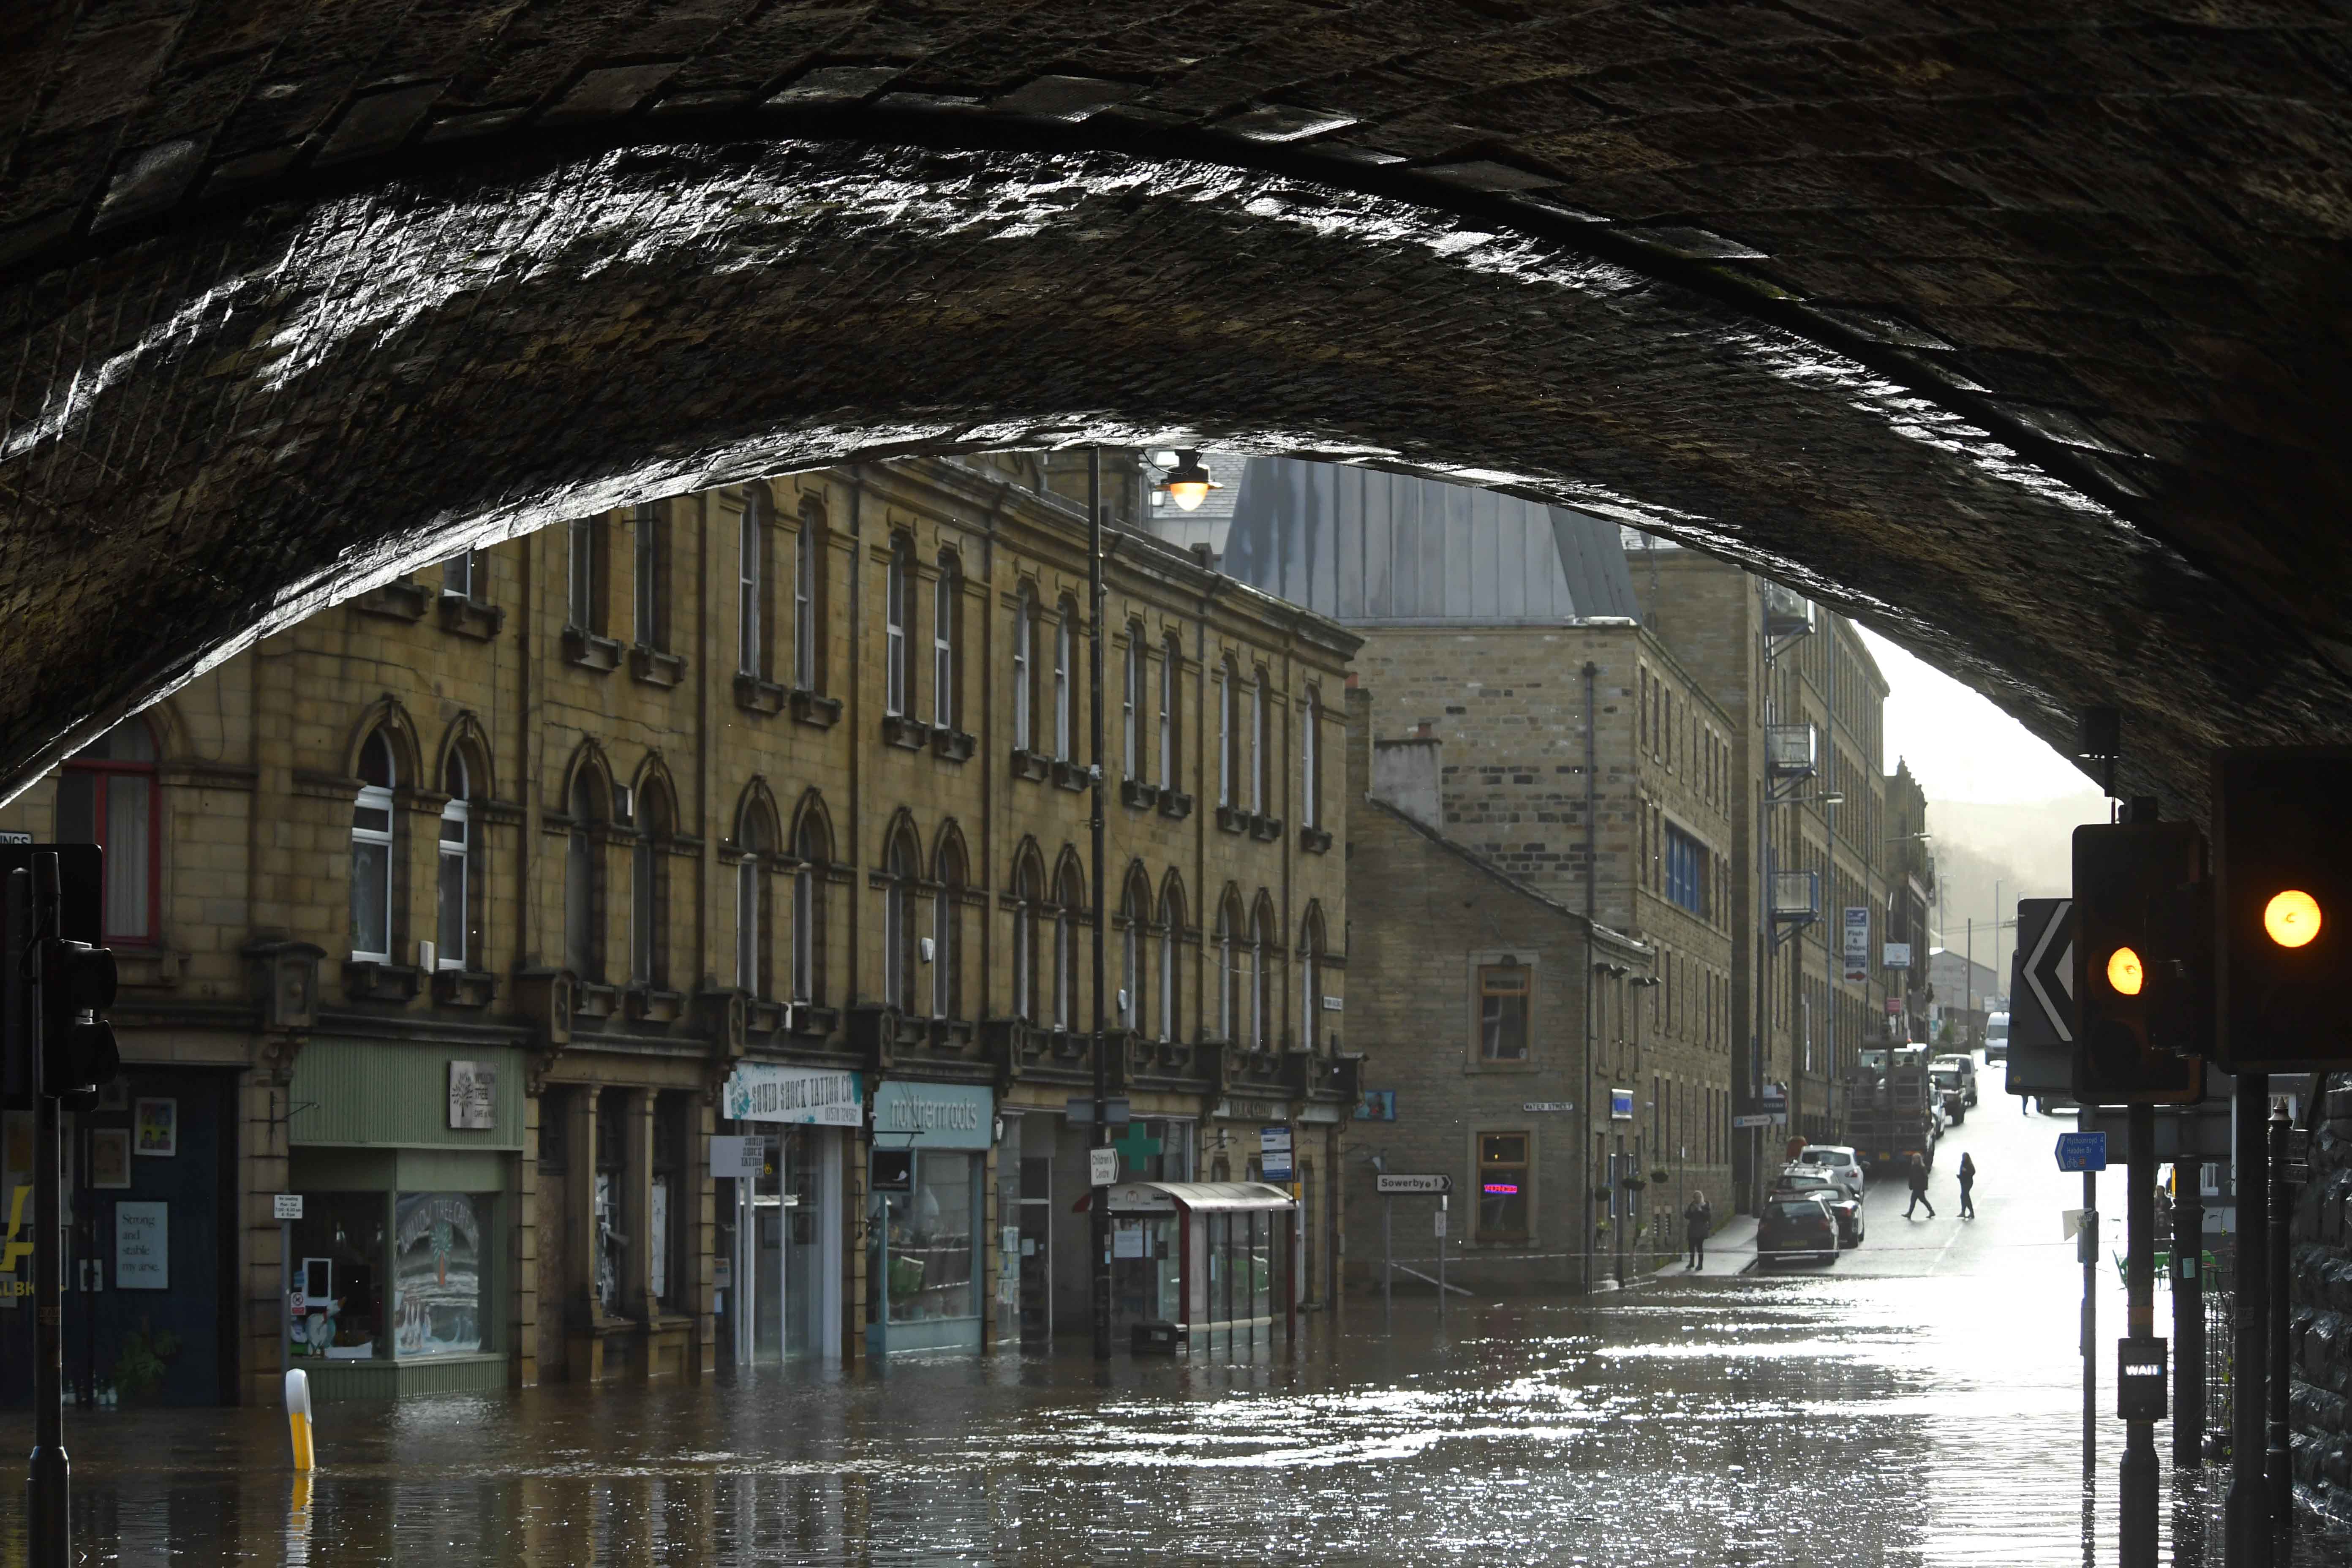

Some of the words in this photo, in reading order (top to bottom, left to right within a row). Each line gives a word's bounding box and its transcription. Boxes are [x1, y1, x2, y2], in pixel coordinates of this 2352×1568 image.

[475, 1088, 487, 1099] TREE
[752, 1082, 777, 1114] SQUID
[780, 1079, 806, 1111] SHOCK
[809, 1075, 838, 1107] TATTOO
[841, 1074, 851, 1102] CO
[745, 1138, 762, 1146] SQUID
[2066, 1136, 2098, 1145] Mytholmroyd
[743, 1147, 762, 1156] SHOCK
[741, 1157, 762, 1166] TATTOO
[1096, 1168, 1109, 1179] Centre
[1382, 1178, 1424, 1188] Sowerby
[122, 1214, 155, 1228] Strong
[122, 1229, 140, 1240] and
[122, 1245, 150, 1255] stable
[122, 1263, 136, 1274] my
[138, 1264, 160, 1272] arse.
[2126, 1364, 2159, 1376] WAIT
